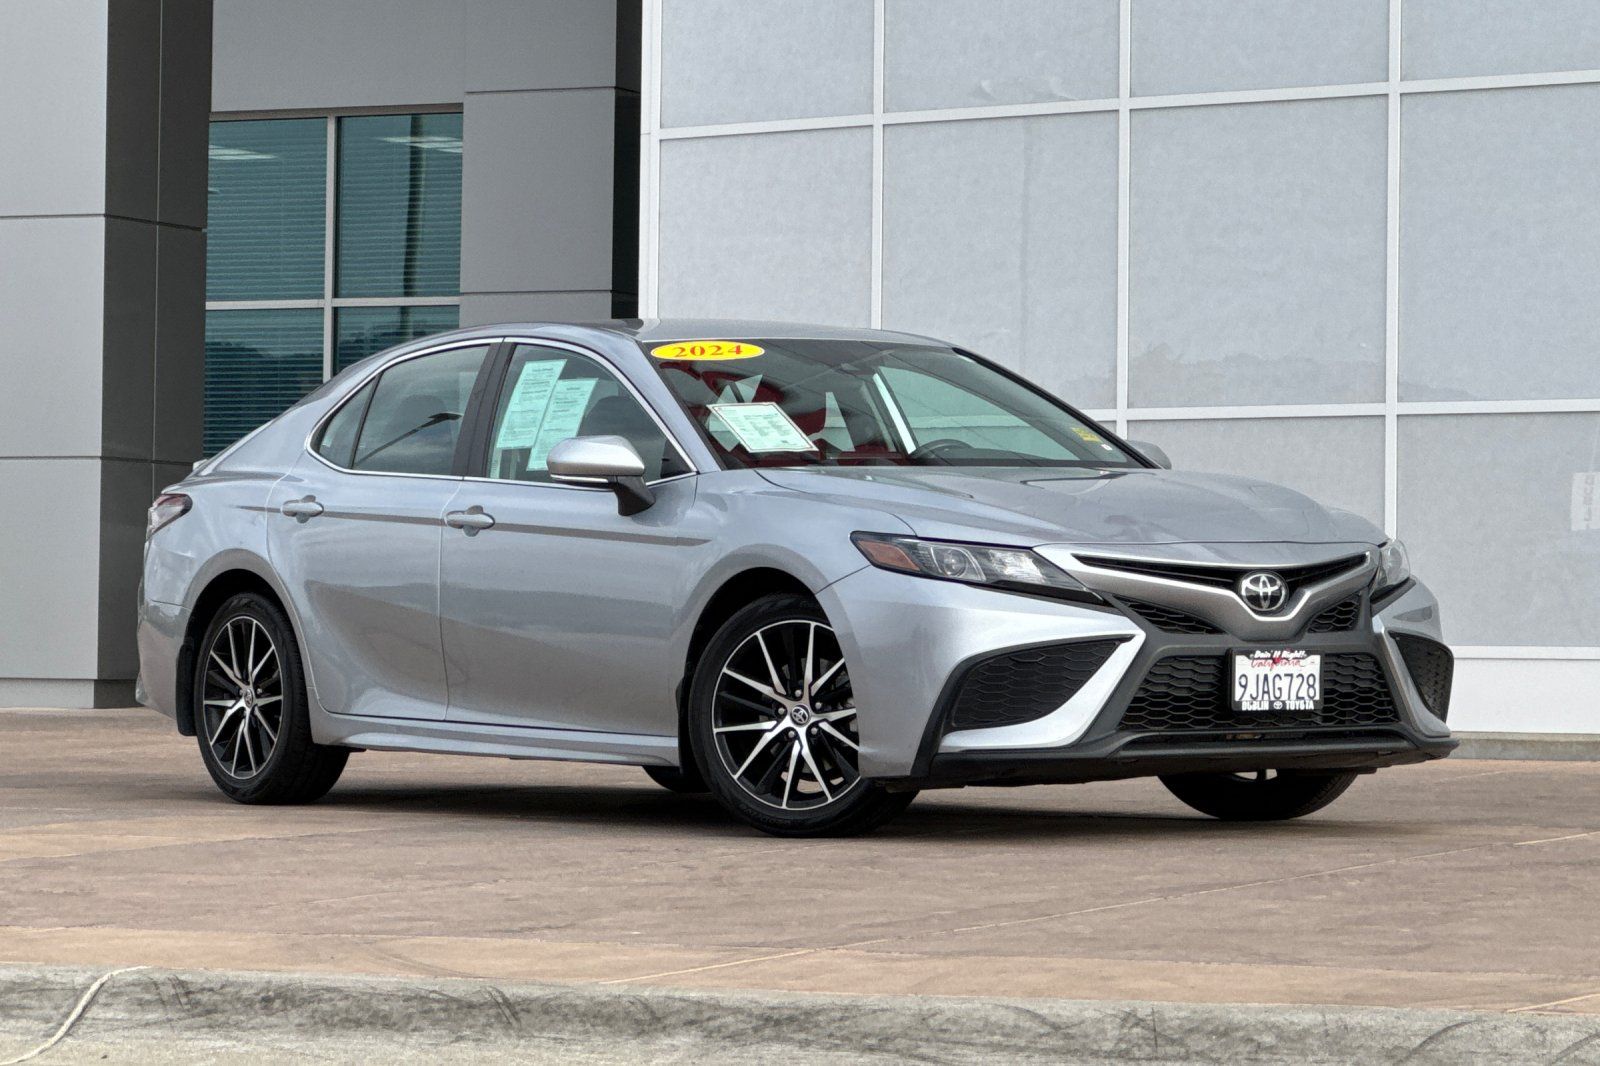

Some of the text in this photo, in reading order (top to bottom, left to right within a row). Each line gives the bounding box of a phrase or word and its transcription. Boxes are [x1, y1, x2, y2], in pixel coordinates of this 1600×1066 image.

[672, 345, 743, 358] 2024
[1251, 659, 1304, 670] Califrnia
[1238, 673, 1316, 700] 9JAG728
[1242, 700, 1314, 710] DUBLIN TOYOTA
